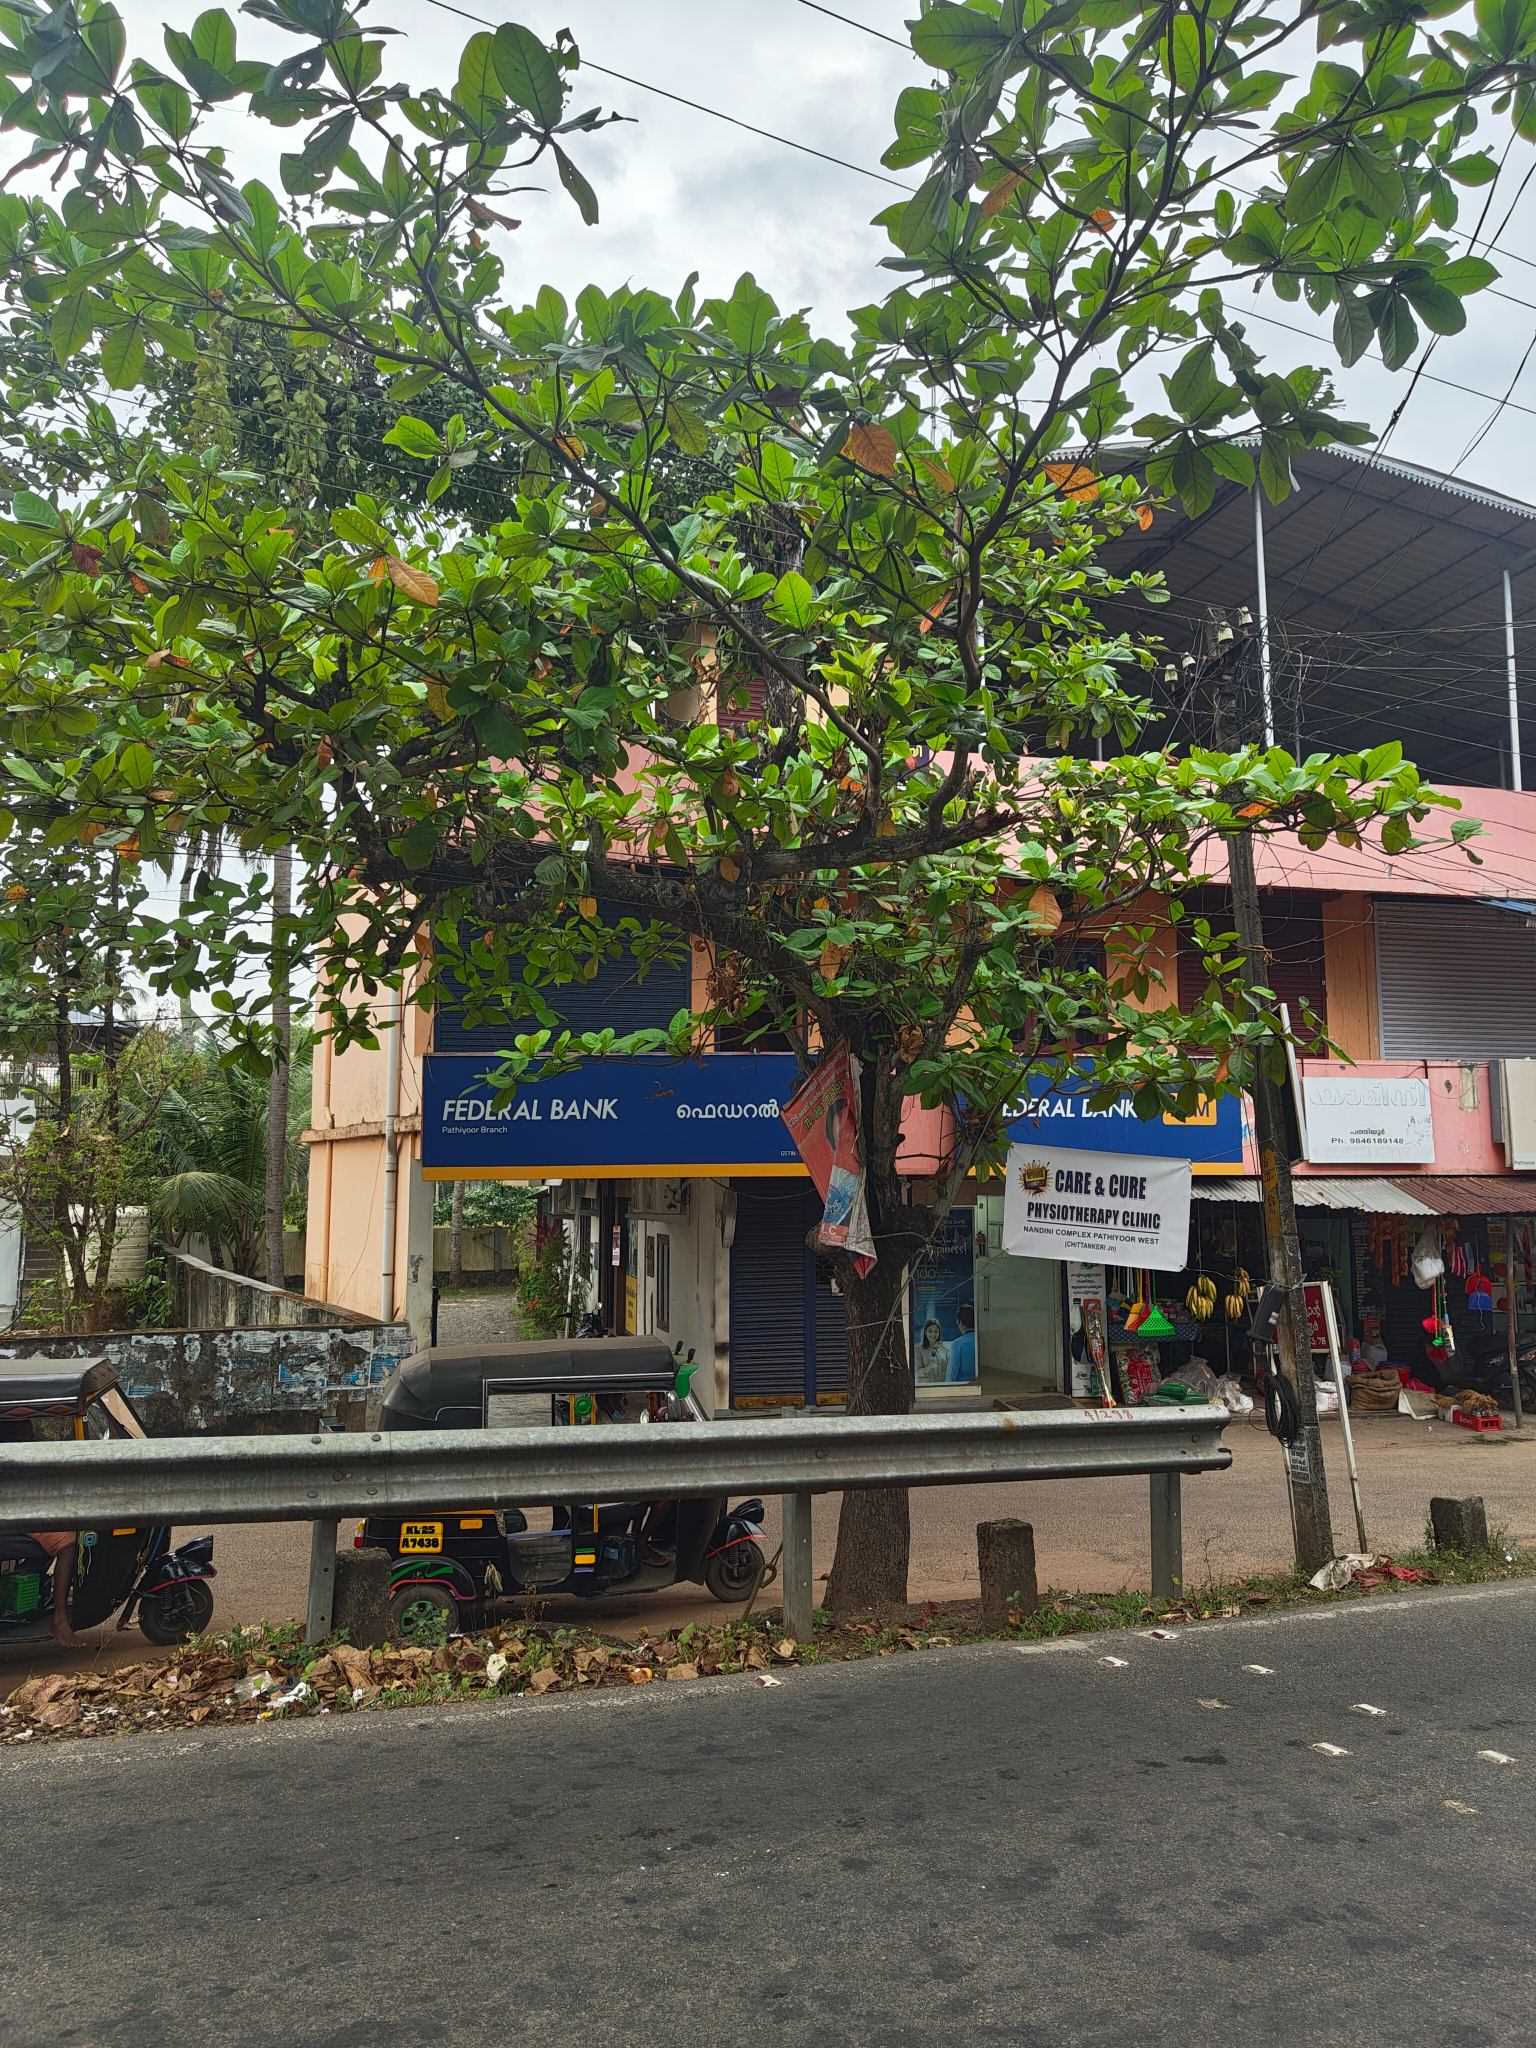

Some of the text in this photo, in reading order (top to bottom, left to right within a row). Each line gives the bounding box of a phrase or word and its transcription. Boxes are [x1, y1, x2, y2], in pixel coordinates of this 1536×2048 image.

[442, 1098, 619, 1121] FEDERAL BANK
[676, 1098, 780, 1119] ഫെഡറൽ
[1001, 1097, 1075, 1118] EDERAL
[441, 1125, 508, 1136] Pathiyoor Branch
[1055, 1169, 1147, 1200] CARE & CURE
[1027, 1201, 1161, 1230] PHYSIOTHERAPY CLINIC
[1023, 1225, 1160, 1246] NANDINI COMPLEX PATHIYOOR WEST
